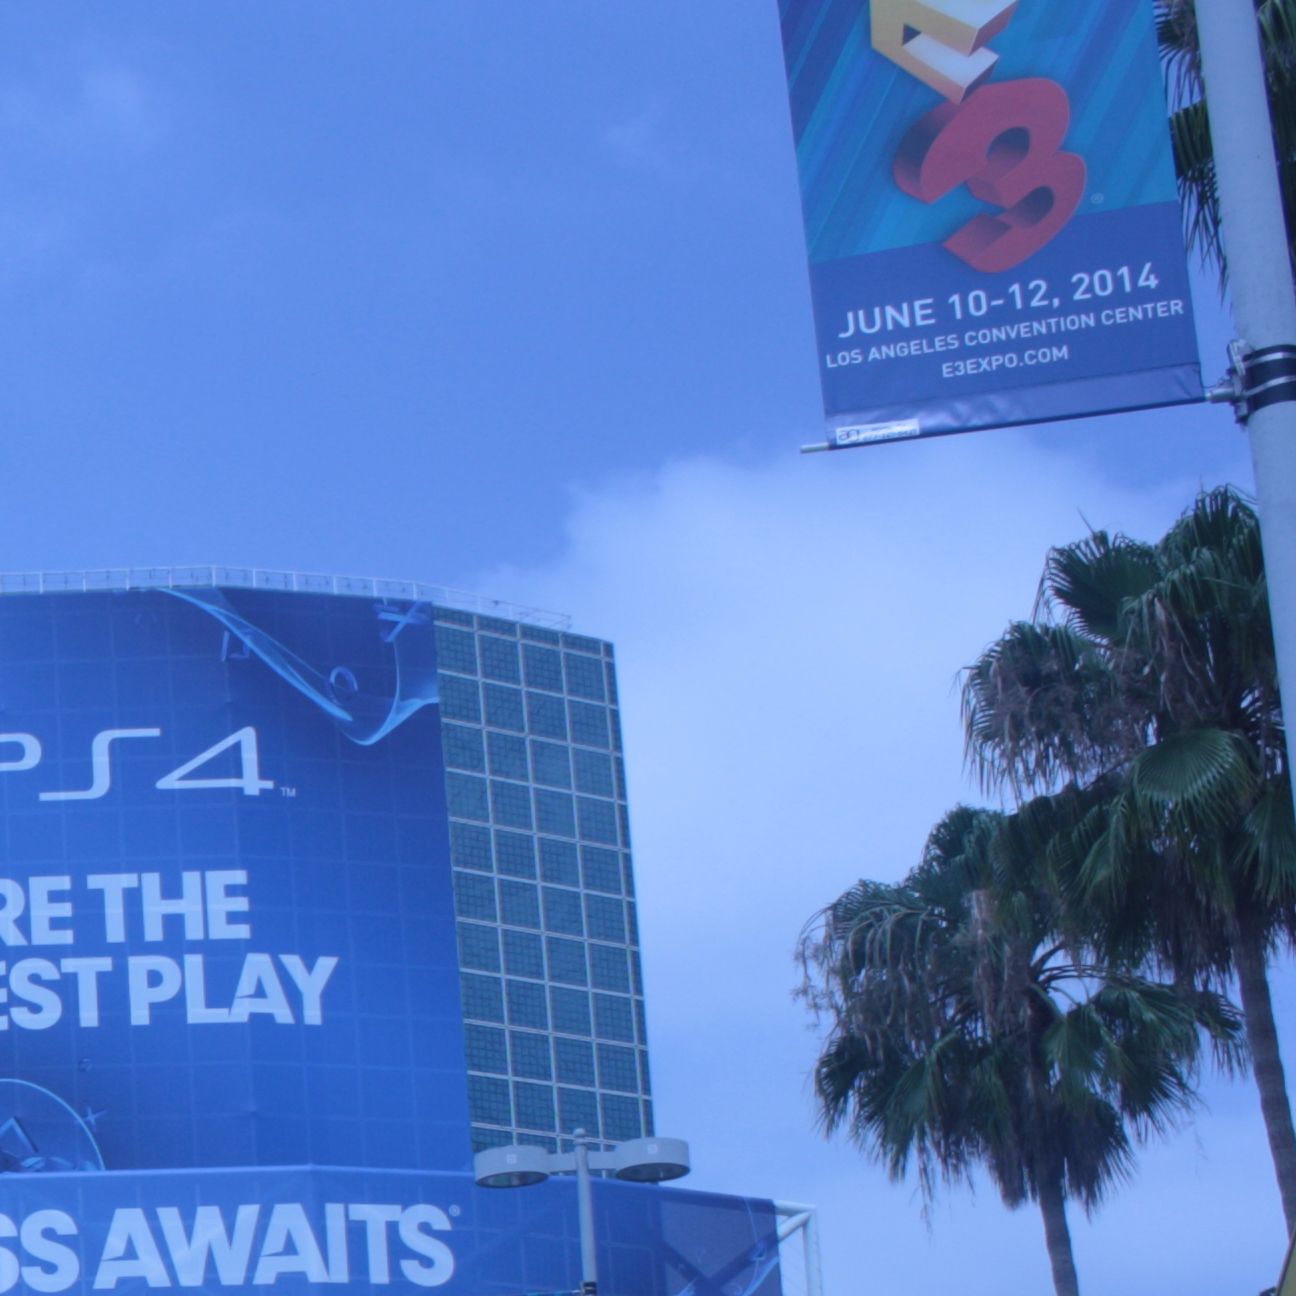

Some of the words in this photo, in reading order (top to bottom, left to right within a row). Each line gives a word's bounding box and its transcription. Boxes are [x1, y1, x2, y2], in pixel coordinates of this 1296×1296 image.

[826, 350, 863, 369] LOS
[868, 335, 960, 363] ANGELES
[964, 313, 1096, 348] CONVENTION
[1101, 299, 1184, 327] CENTER
[838, 297, 936, 339] JUNE
[947, 278, 1061, 322] 10-12,
[1071, 262, 1160, 301] 2014
[941, 345, 1069, 379] E3EXPO.COM
[87, 869, 251, 943] THE
[127, 953, 339, 1027] PLAY
[94, 1202, 456, 1291] AWAITS
